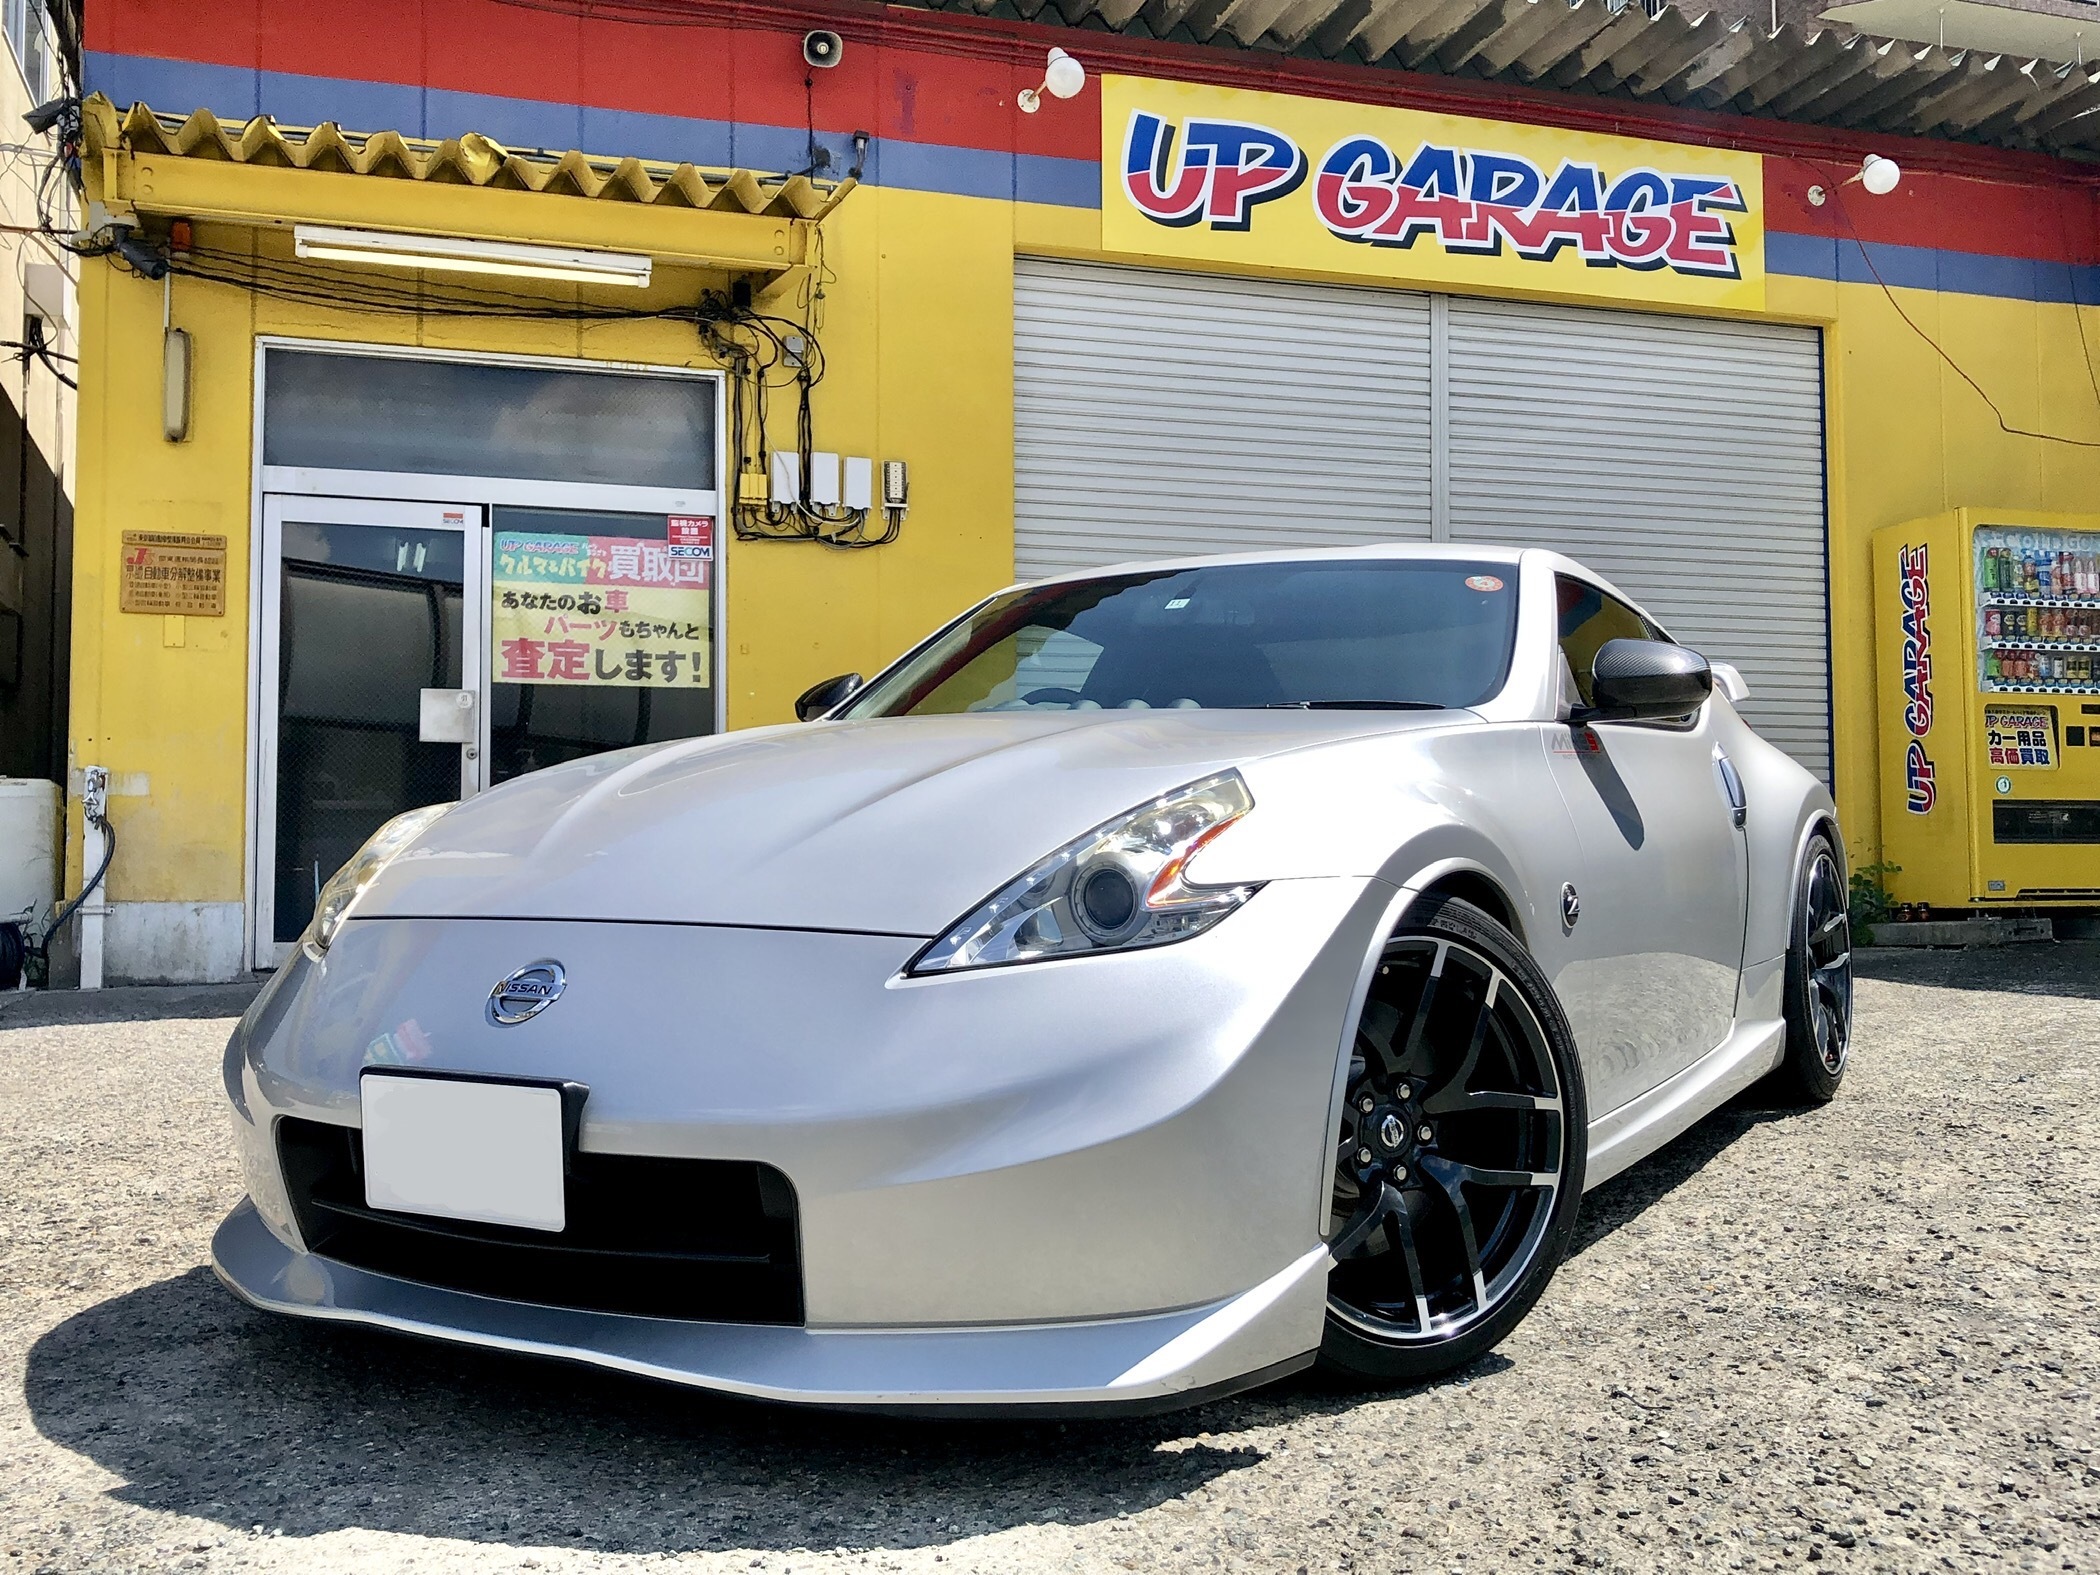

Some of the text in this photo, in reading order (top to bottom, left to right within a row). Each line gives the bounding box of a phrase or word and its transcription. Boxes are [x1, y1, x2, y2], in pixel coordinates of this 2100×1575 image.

[1122, 108, 1748, 280] UP GARAGE
[500, 539, 523, 553] UP
[523, 540, 580, 555] GARAGE
[670, 546, 710, 557] SECOM
[501, 589, 629, 614] あなたのお車
[544, 614, 700, 641] パーツもちゃんと
[500, 637, 702, 683] 査定します!
[1898, 543, 1936, 816] UP GARAGE
[2000, 715, 2049, 729] GARAGE
[1988, 730, 2047, 747] カー用品
[1989, 747, 2050, 765] 高価買取
[493, 981, 552, 995] NISSAN
